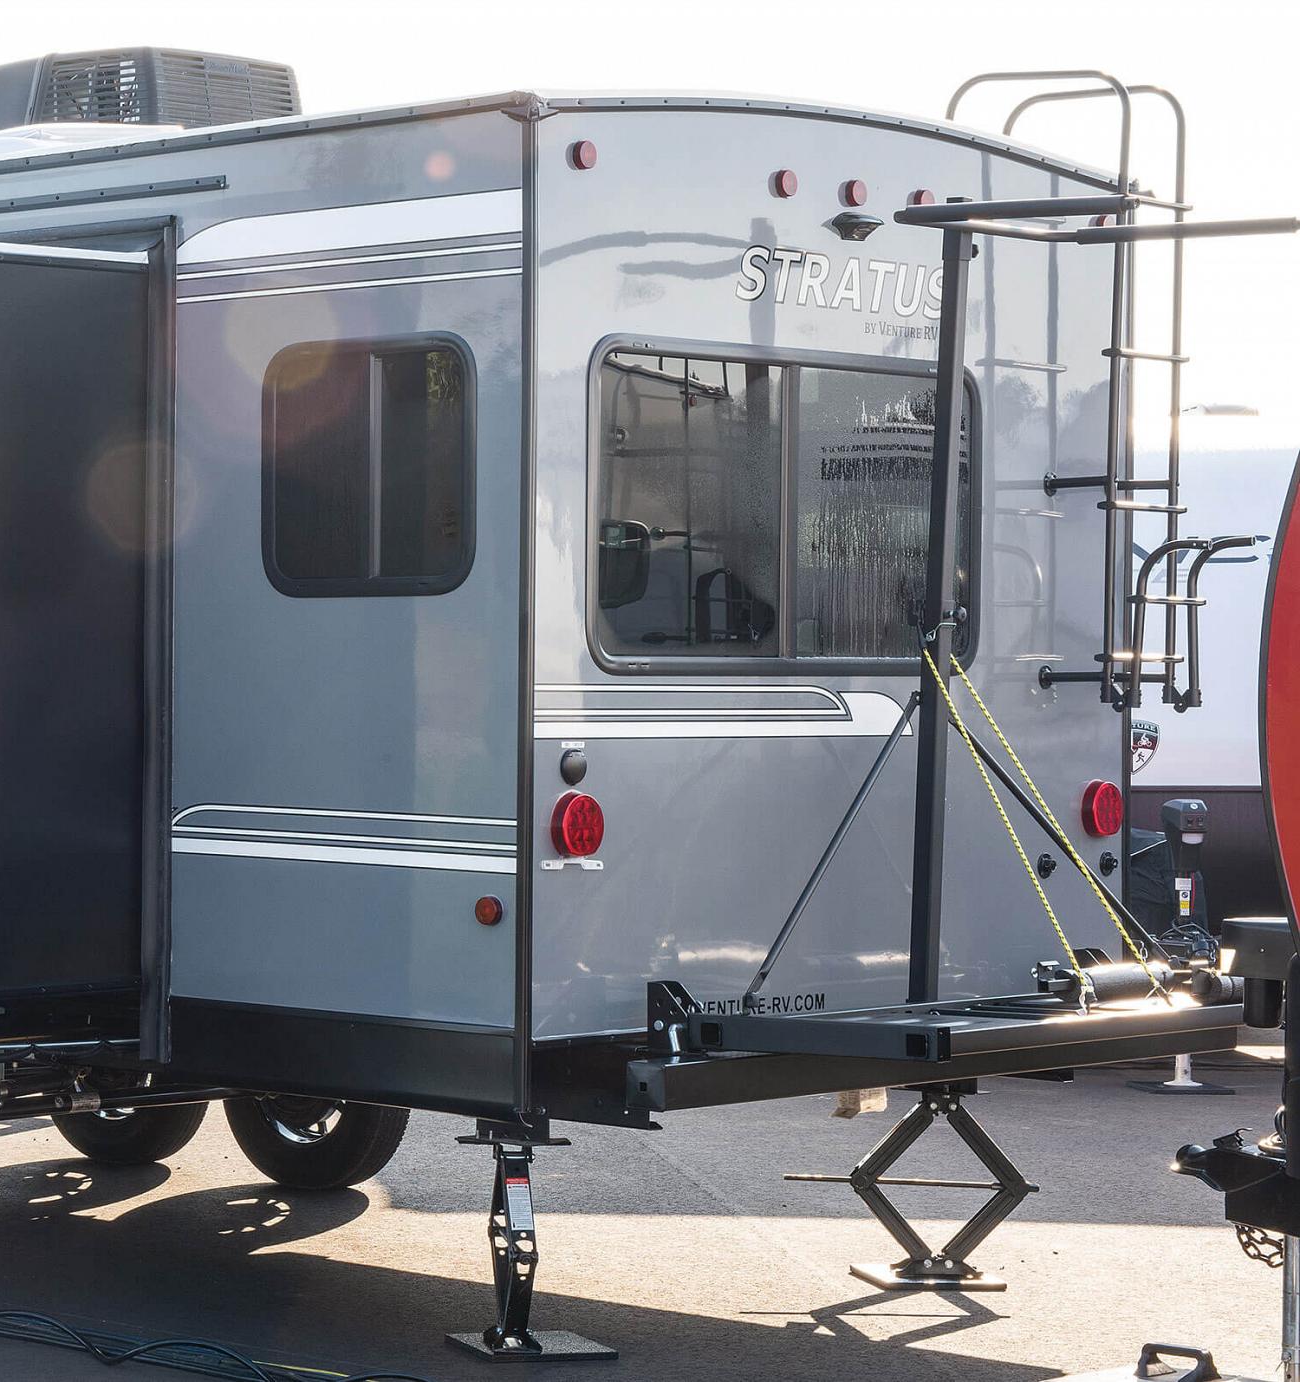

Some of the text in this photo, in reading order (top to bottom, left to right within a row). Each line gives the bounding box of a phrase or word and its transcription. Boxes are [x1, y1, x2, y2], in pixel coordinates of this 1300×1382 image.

[735, 245, 943, 320] STRATUS
[863, 320, 939, 341] BY VENTURE RV
[701, 993, 825, 1015] ENTE-RV.COM
